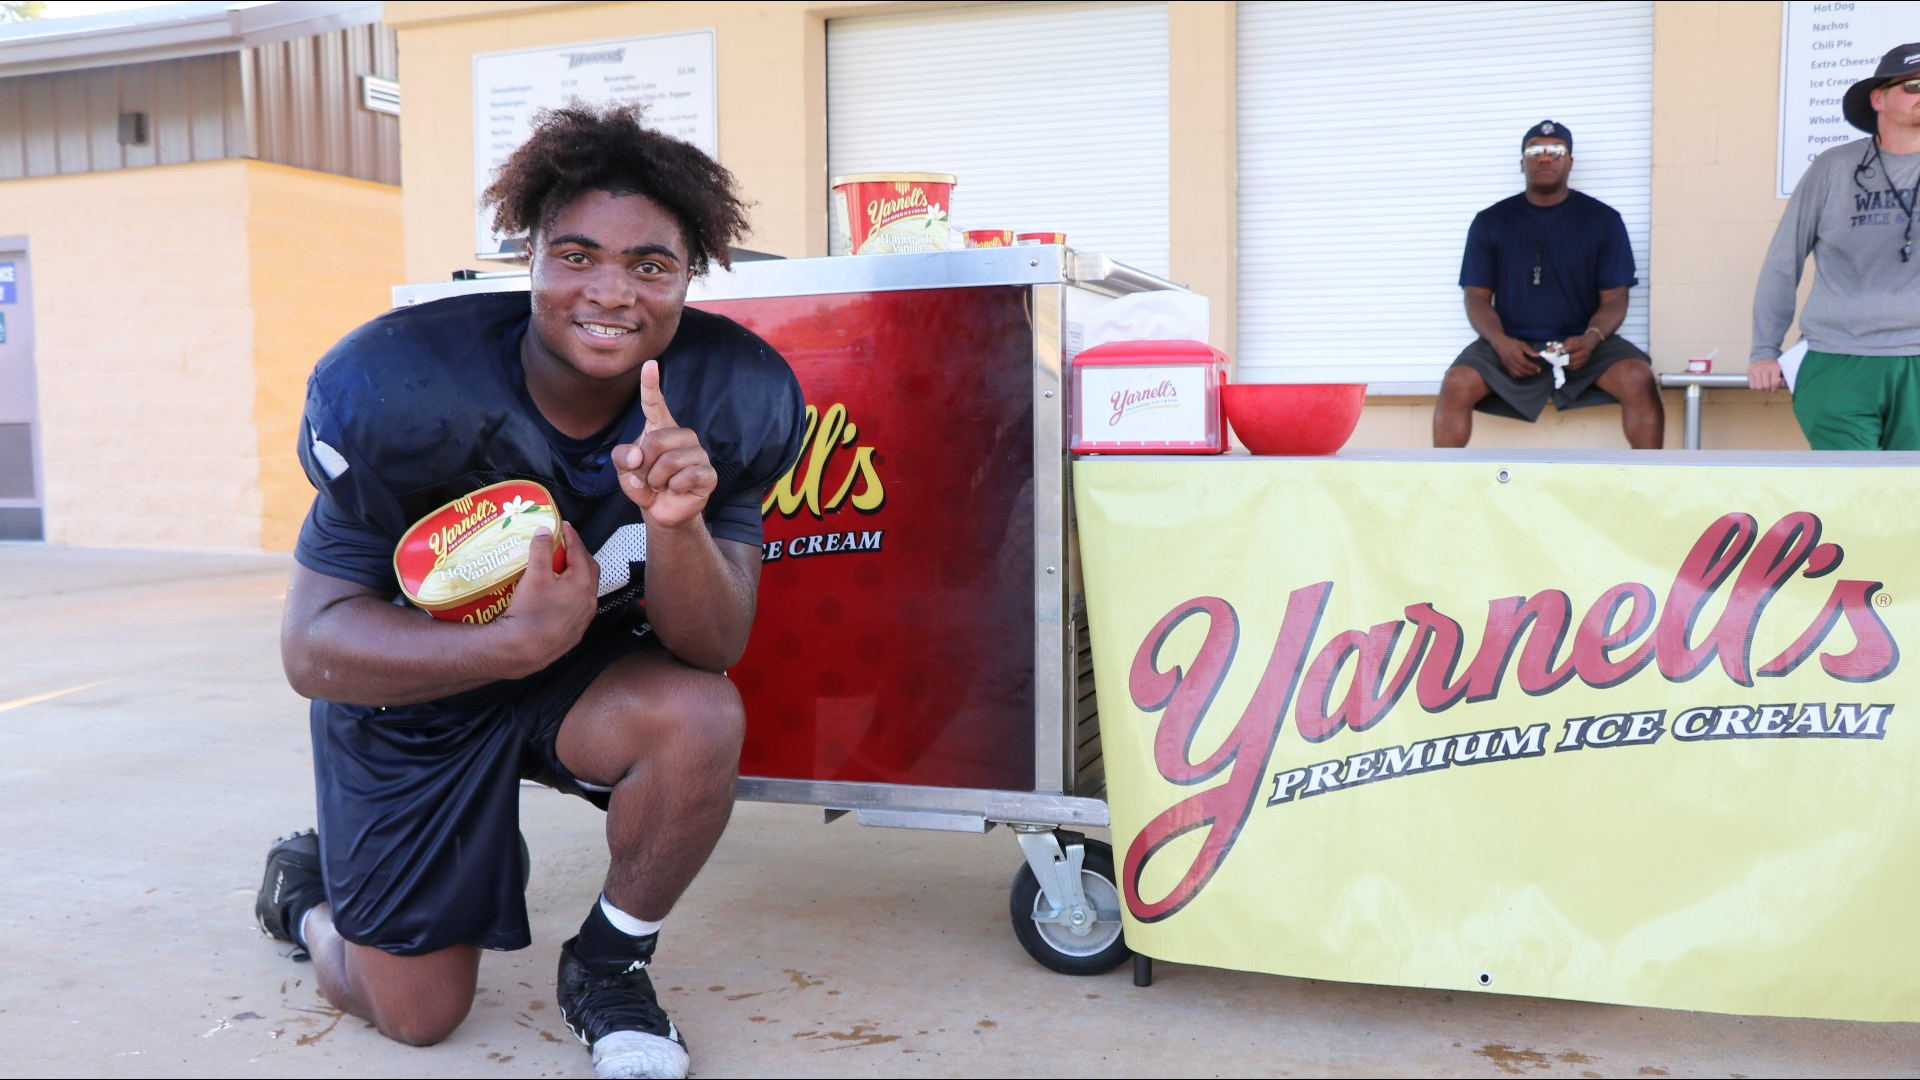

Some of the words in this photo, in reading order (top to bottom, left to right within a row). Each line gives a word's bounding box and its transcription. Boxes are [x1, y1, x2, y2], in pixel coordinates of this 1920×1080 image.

[1813, 4, 1831, 13] Hot
[1834, 2, 1855, 12] Dog
[1812, 21, 1849, 32] Nachos
[1812, 41, 1834, 51] Chili
[1837, 39, 1853, 48] Pie
[1811, 61, 1837, 70] Extra
[1810, 80, 1824, 88] Ice
[1809, 115, 1841, 125] Whole
[1808, 135, 1849, 145] Popcorn
[867, 187, 928, 242] Yarnell's
[881, 232, 933, 244] Homemade
[1109, 380, 1177, 426] Yarnell's
[429, 499, 497, 570] Yarnell's
[447, 530, 473, 552] PREMIUM
[480, 512, 499, 527] CREAM
[788, 530, 884, 557] CREAM
[440, 536, 523, 581] Homemade
[461, 554, 511, 582] Vanilla
[1123, 511, 1900, 924] Yarnell's
[1266, 722, 1551, 808] PREMIUM
[1554, 709, 1667, 753] ICE
[1671, 703, 1895, 742] CREAM
